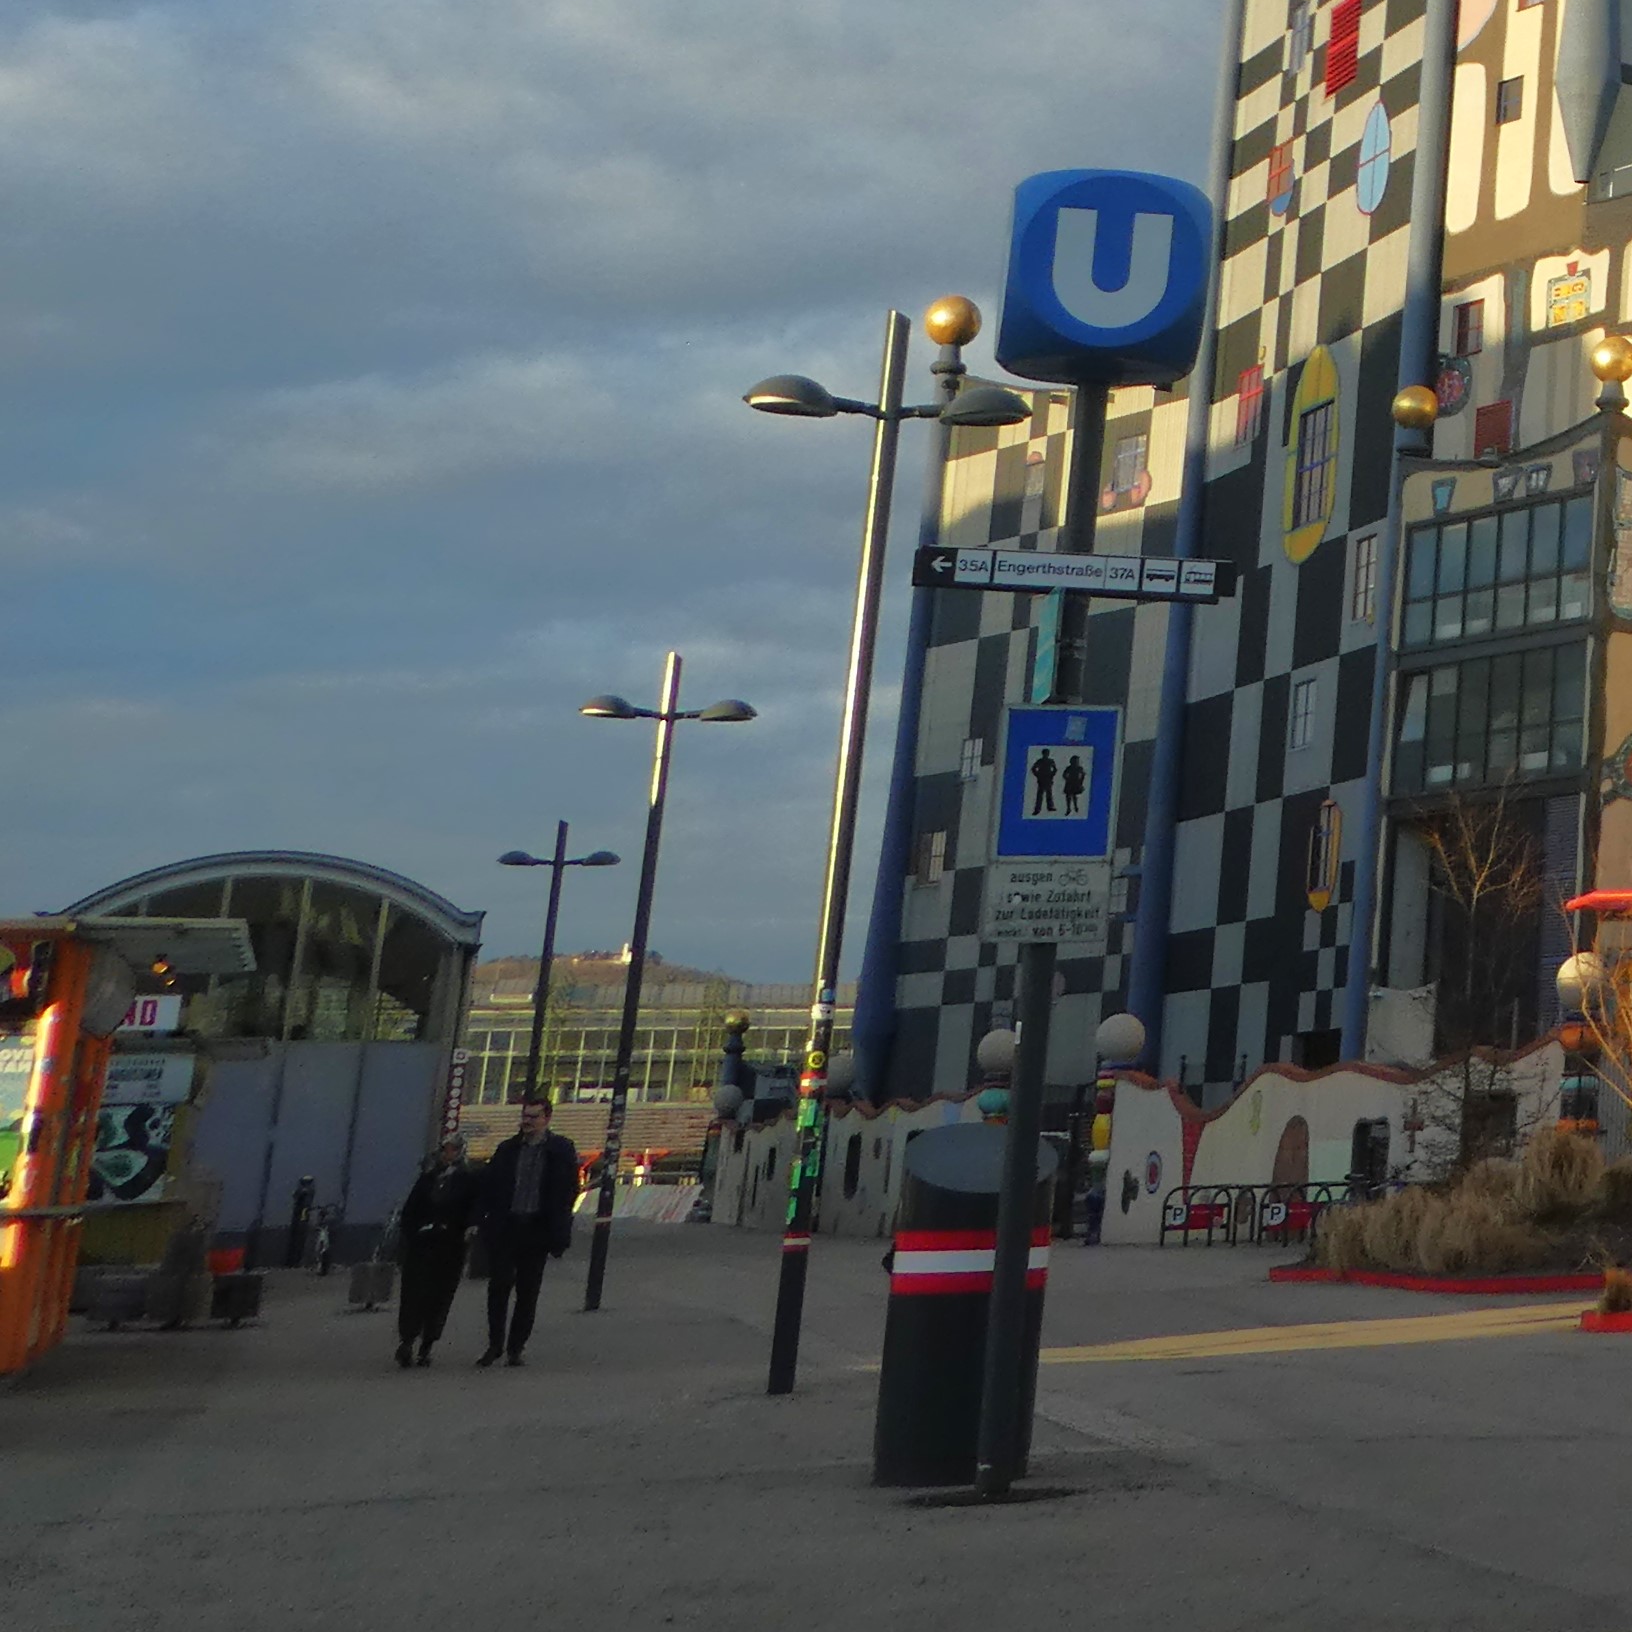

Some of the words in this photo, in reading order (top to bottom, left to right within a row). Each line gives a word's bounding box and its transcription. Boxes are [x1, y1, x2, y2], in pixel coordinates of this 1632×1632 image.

[1052, 207, 1174, 328] U
[958, 558, 988, 573] 35A
[997, 559, 1104, 578] Engerthstraße
[1109, 567, 1136, 581] 37A
[1032, 926, 1054, 937] von
[1172, 1207, 1184, 1221] P
[1270, 1206, 1282, 1221] P
